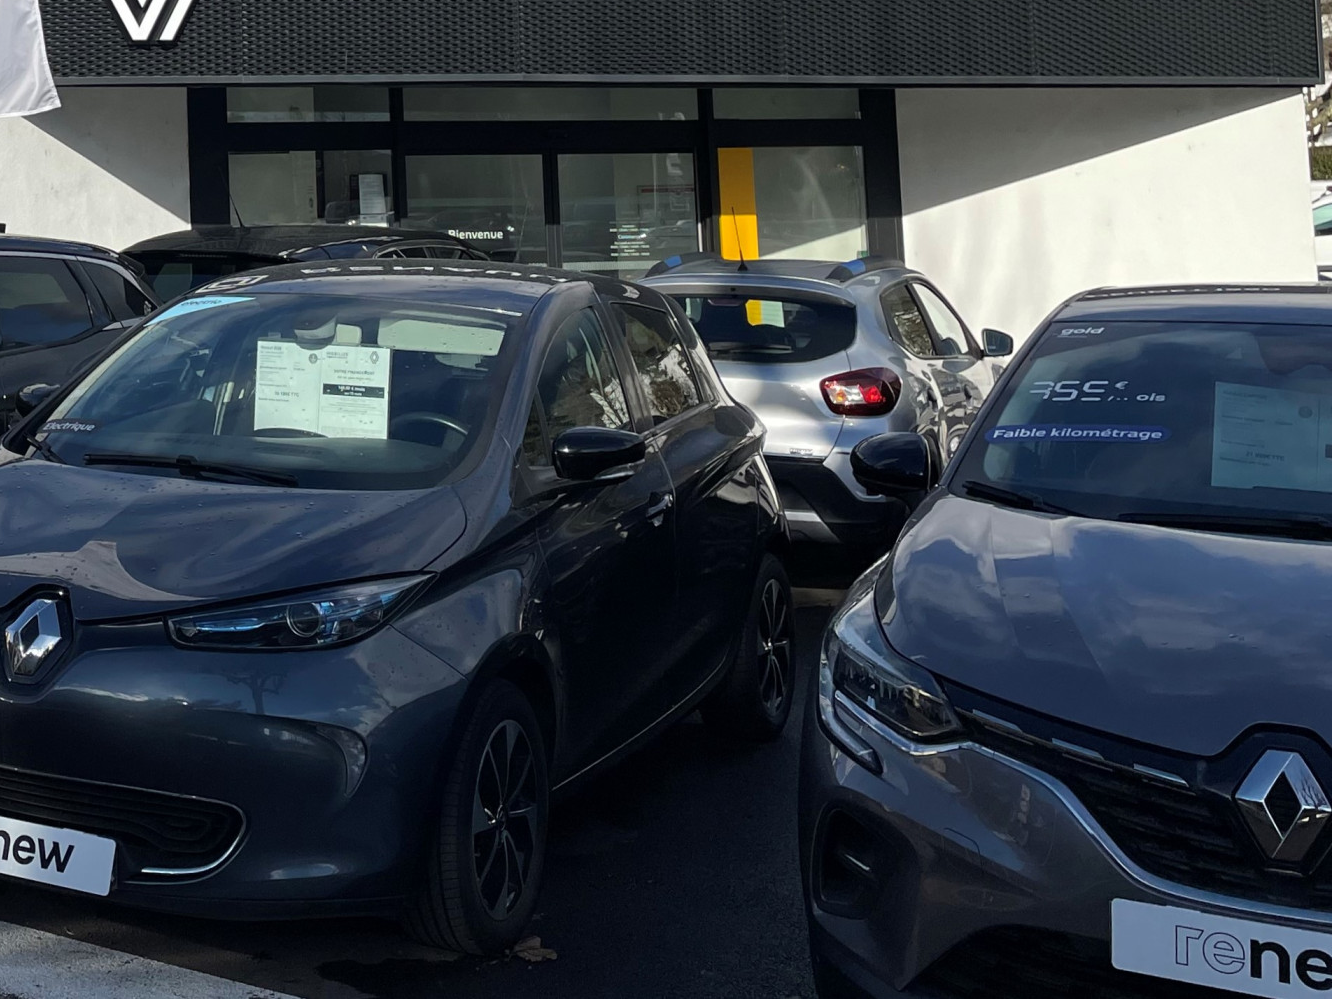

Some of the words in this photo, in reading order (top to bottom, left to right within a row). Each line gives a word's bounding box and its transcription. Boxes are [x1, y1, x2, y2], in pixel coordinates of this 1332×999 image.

[448, 229, 504, 240] Bienvenue
[1060, 326, 1106, 336] gold
[992, 426, 1047, 439] Faible
[1049, 427, 1163, 441] kilométrage
